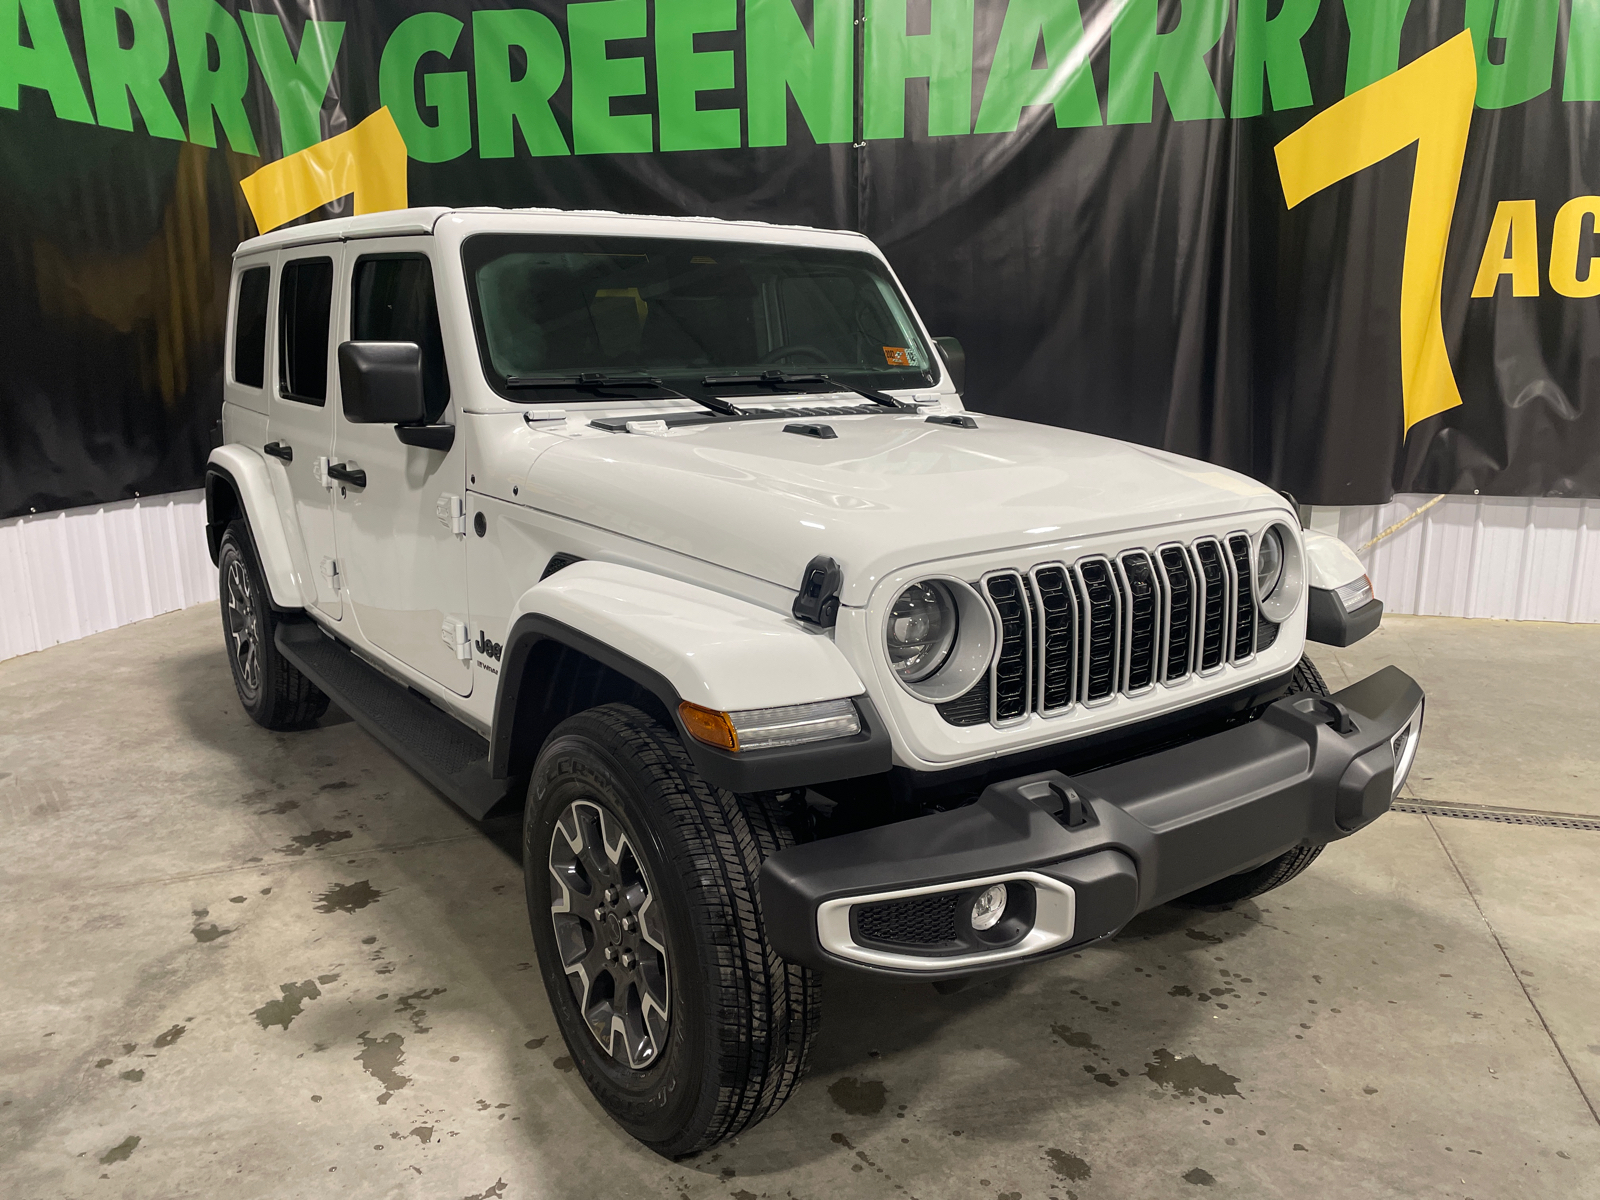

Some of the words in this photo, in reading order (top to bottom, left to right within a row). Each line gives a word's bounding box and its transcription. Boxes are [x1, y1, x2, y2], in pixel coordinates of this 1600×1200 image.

[379, 0, 853, 163] GREEN
[1464, 0, 1600, 110] G
[1274, 27, 1477, 436] 7
[475, 629, 504, 663] Jee
